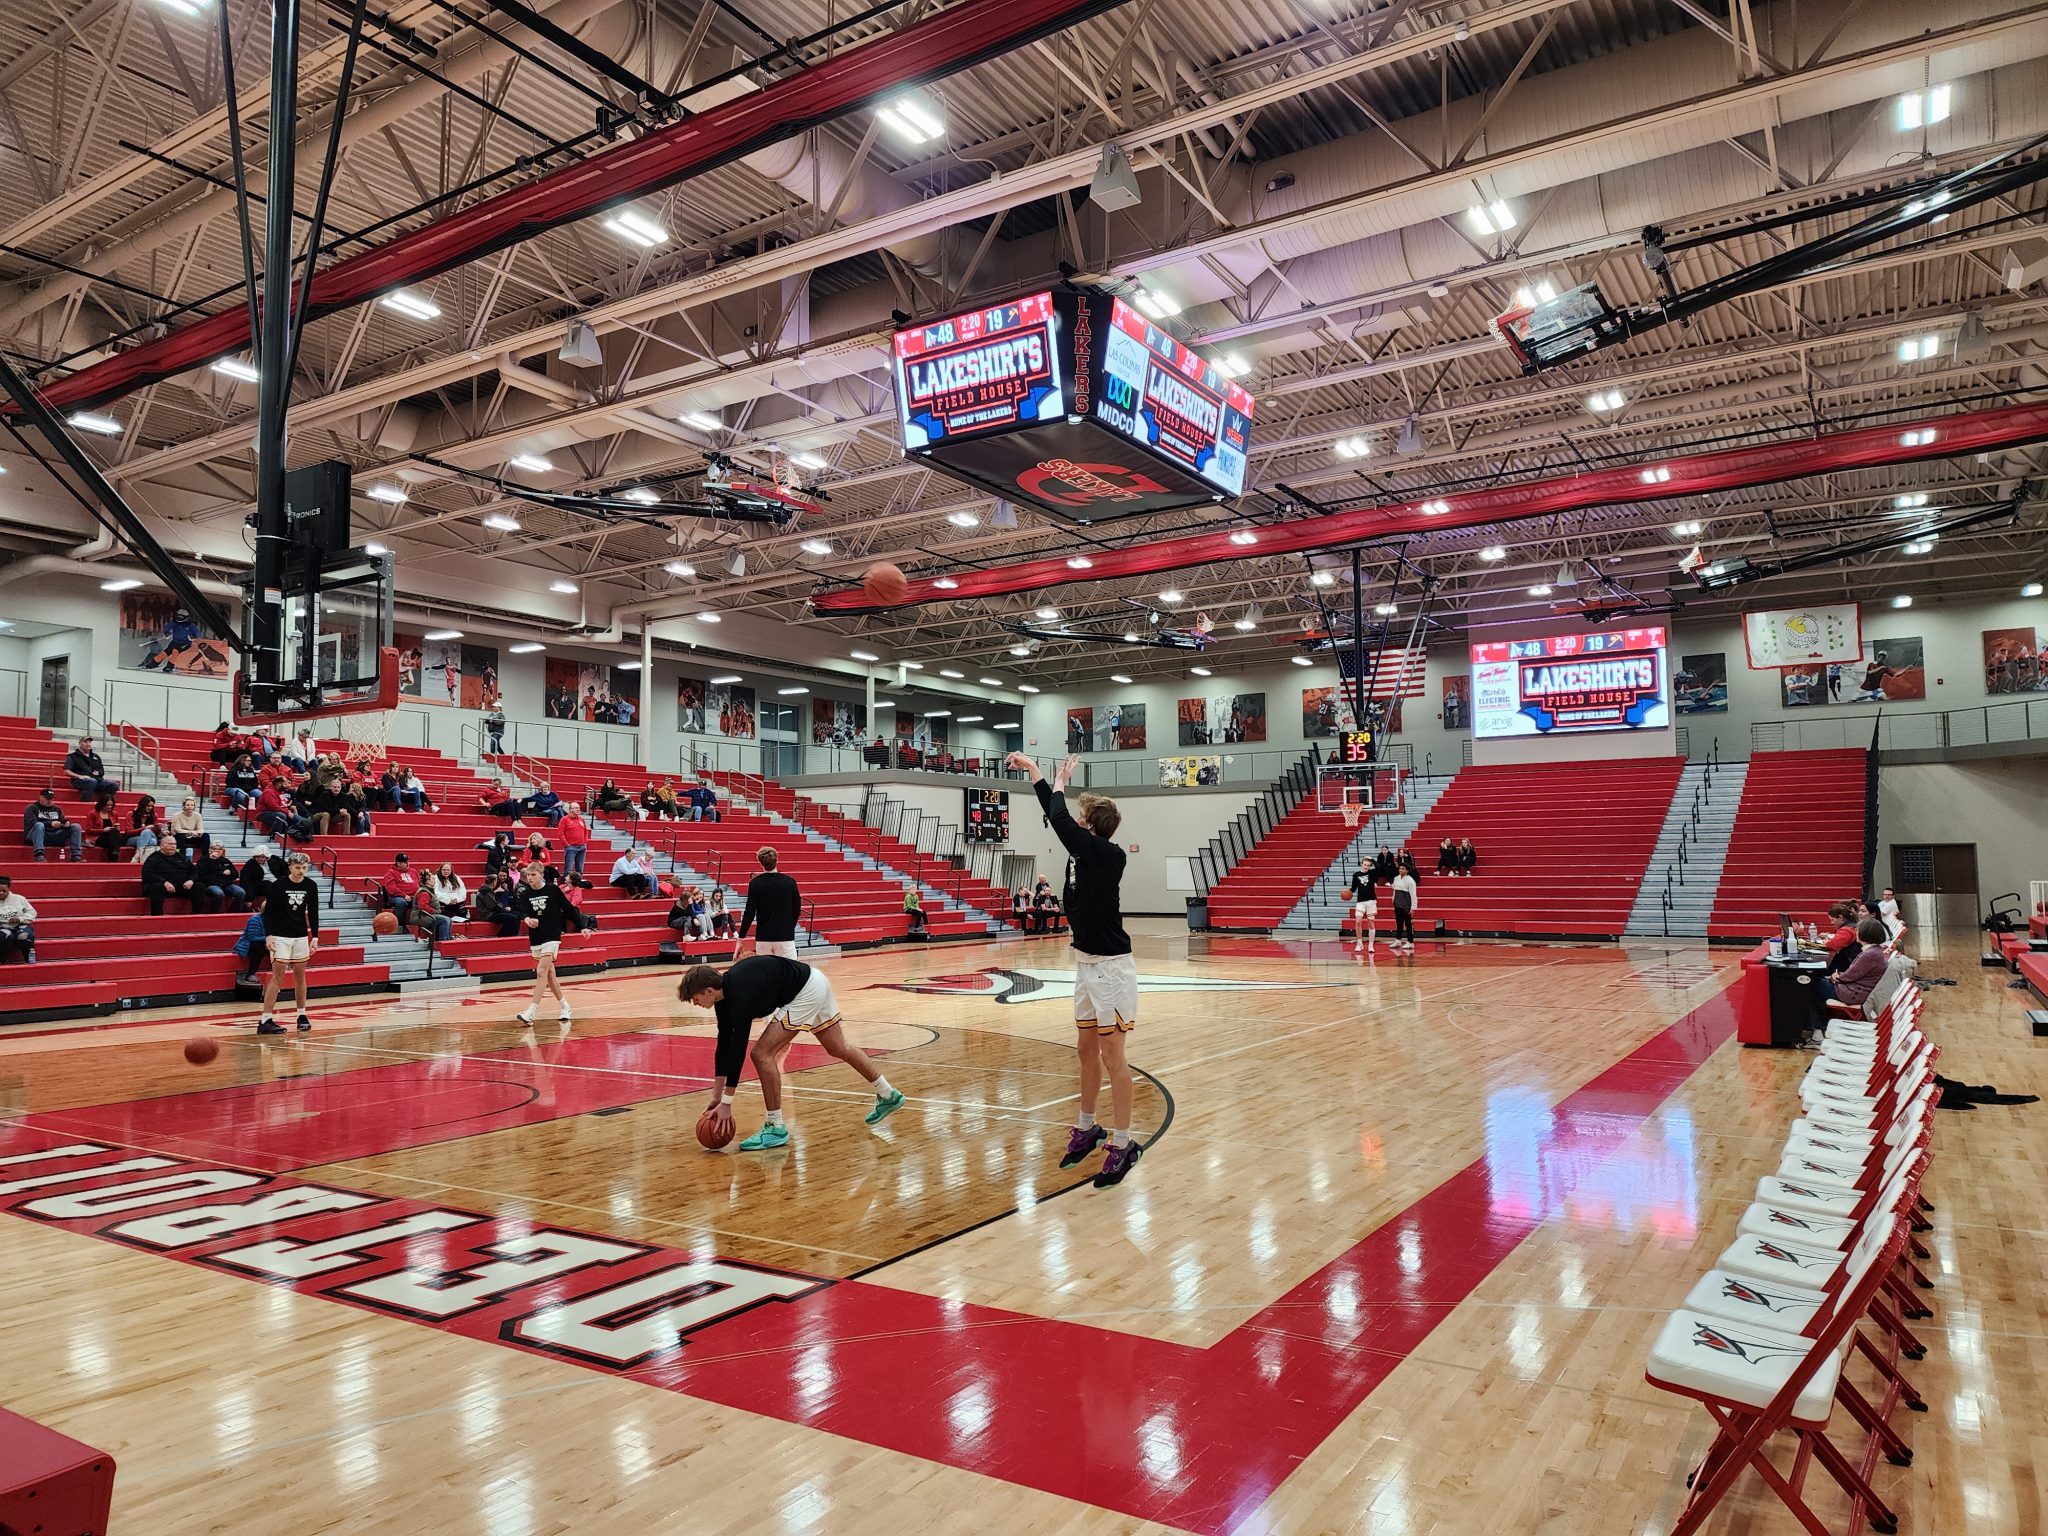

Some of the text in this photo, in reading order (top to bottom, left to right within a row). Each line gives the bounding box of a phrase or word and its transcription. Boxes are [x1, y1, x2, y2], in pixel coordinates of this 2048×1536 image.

[960, 314, 980, 331] 2:20
[986, 310, 1003, 331] 19
[938, 323, 954, 344] 48
[1073, 296, 1090, 414] LAKERS
[1108, 346, 1118, 361] LAS
[1119, 354, 1141, 376] COLINAS
[910, 334, 1044, 402] LAKESHIRTS
[1208, 370, 1216, 388] 19
[937, 380, 1022, 410] FIELD HOUSE
[1148, 366, 1218, 435] LAKESHIRTS
[950, 406, 1012, 428] HOME OF THE LAKERS
[1097, 400, 1135, 434] MIDCO
[1158, 408, 1203, 442] FIELD HOUSE
[1036, 458, 1144, 502] LAKERS
[290, 508, 320, 519] TRONICS
[1524, 642, 1541, 656] 48
[1556, 637, 1576, 649] 2:20
[1588, 636, 1604, 651] 19
[1524, 658, 1653, 696] LAKESHIRTS
[1478, 696, 1510, 704] ELECTRIC
[1547, 692, 1630, 706] FIELD HOUSE
[1492, 716, 1512, 726] arvig
[1347, 732, 1370, 744] 2:20
[1347, 744, 1367, 762] 35
[1001, 812, 1008, 822] 19
